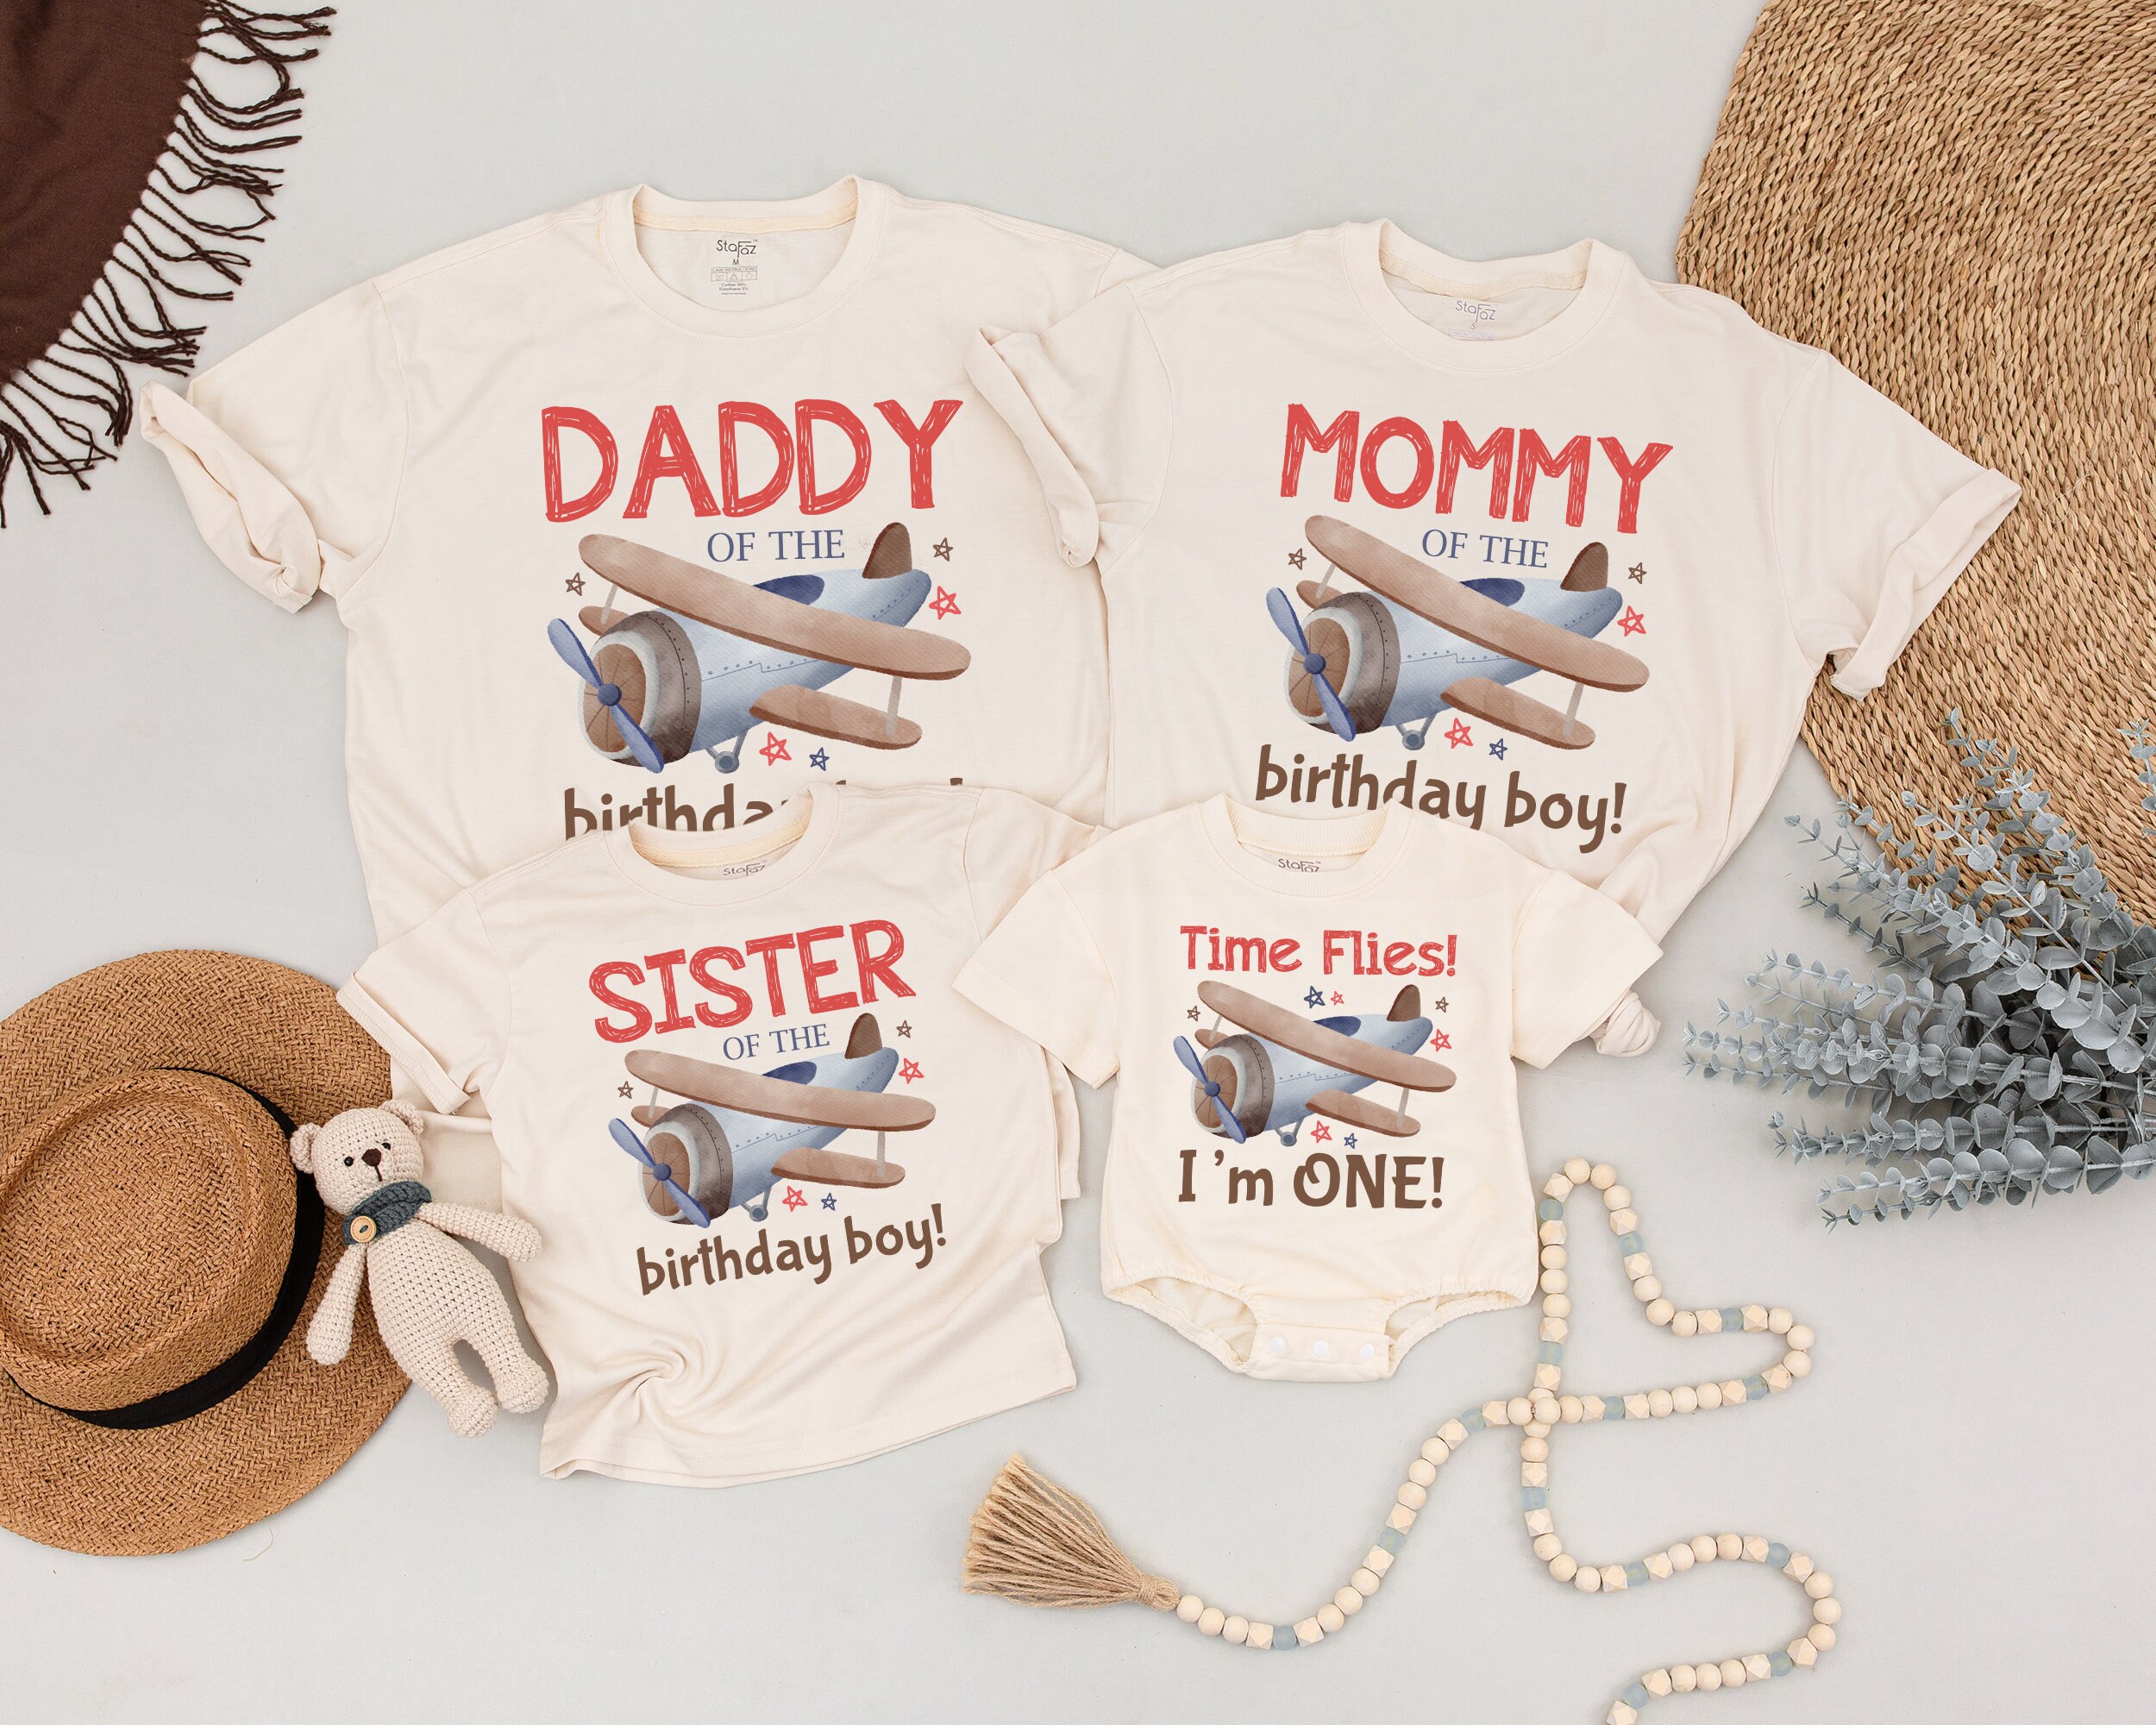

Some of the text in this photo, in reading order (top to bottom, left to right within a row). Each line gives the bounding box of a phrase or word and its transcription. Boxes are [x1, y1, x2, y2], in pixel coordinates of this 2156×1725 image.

[541, 398, 963, 523] DADDY
[1280, 404, 1673, 534] MOMMY
[707, 529, 845, 562] OF THE
[1421, 529, 1549, 569] OF THE
[564, 782, 789, 841] birthd
[1255, 744, 1627, 854] birthday boy!
[1180, 925, 1457, 977] Time Flies!
[589, 919, 917, 1044] SISTER
[723, 1024, 830, 1060] OF THE
[1293, 1152, 1445, 1209] ONE!
[636, 1203, 947, 1295] birthday boy!
